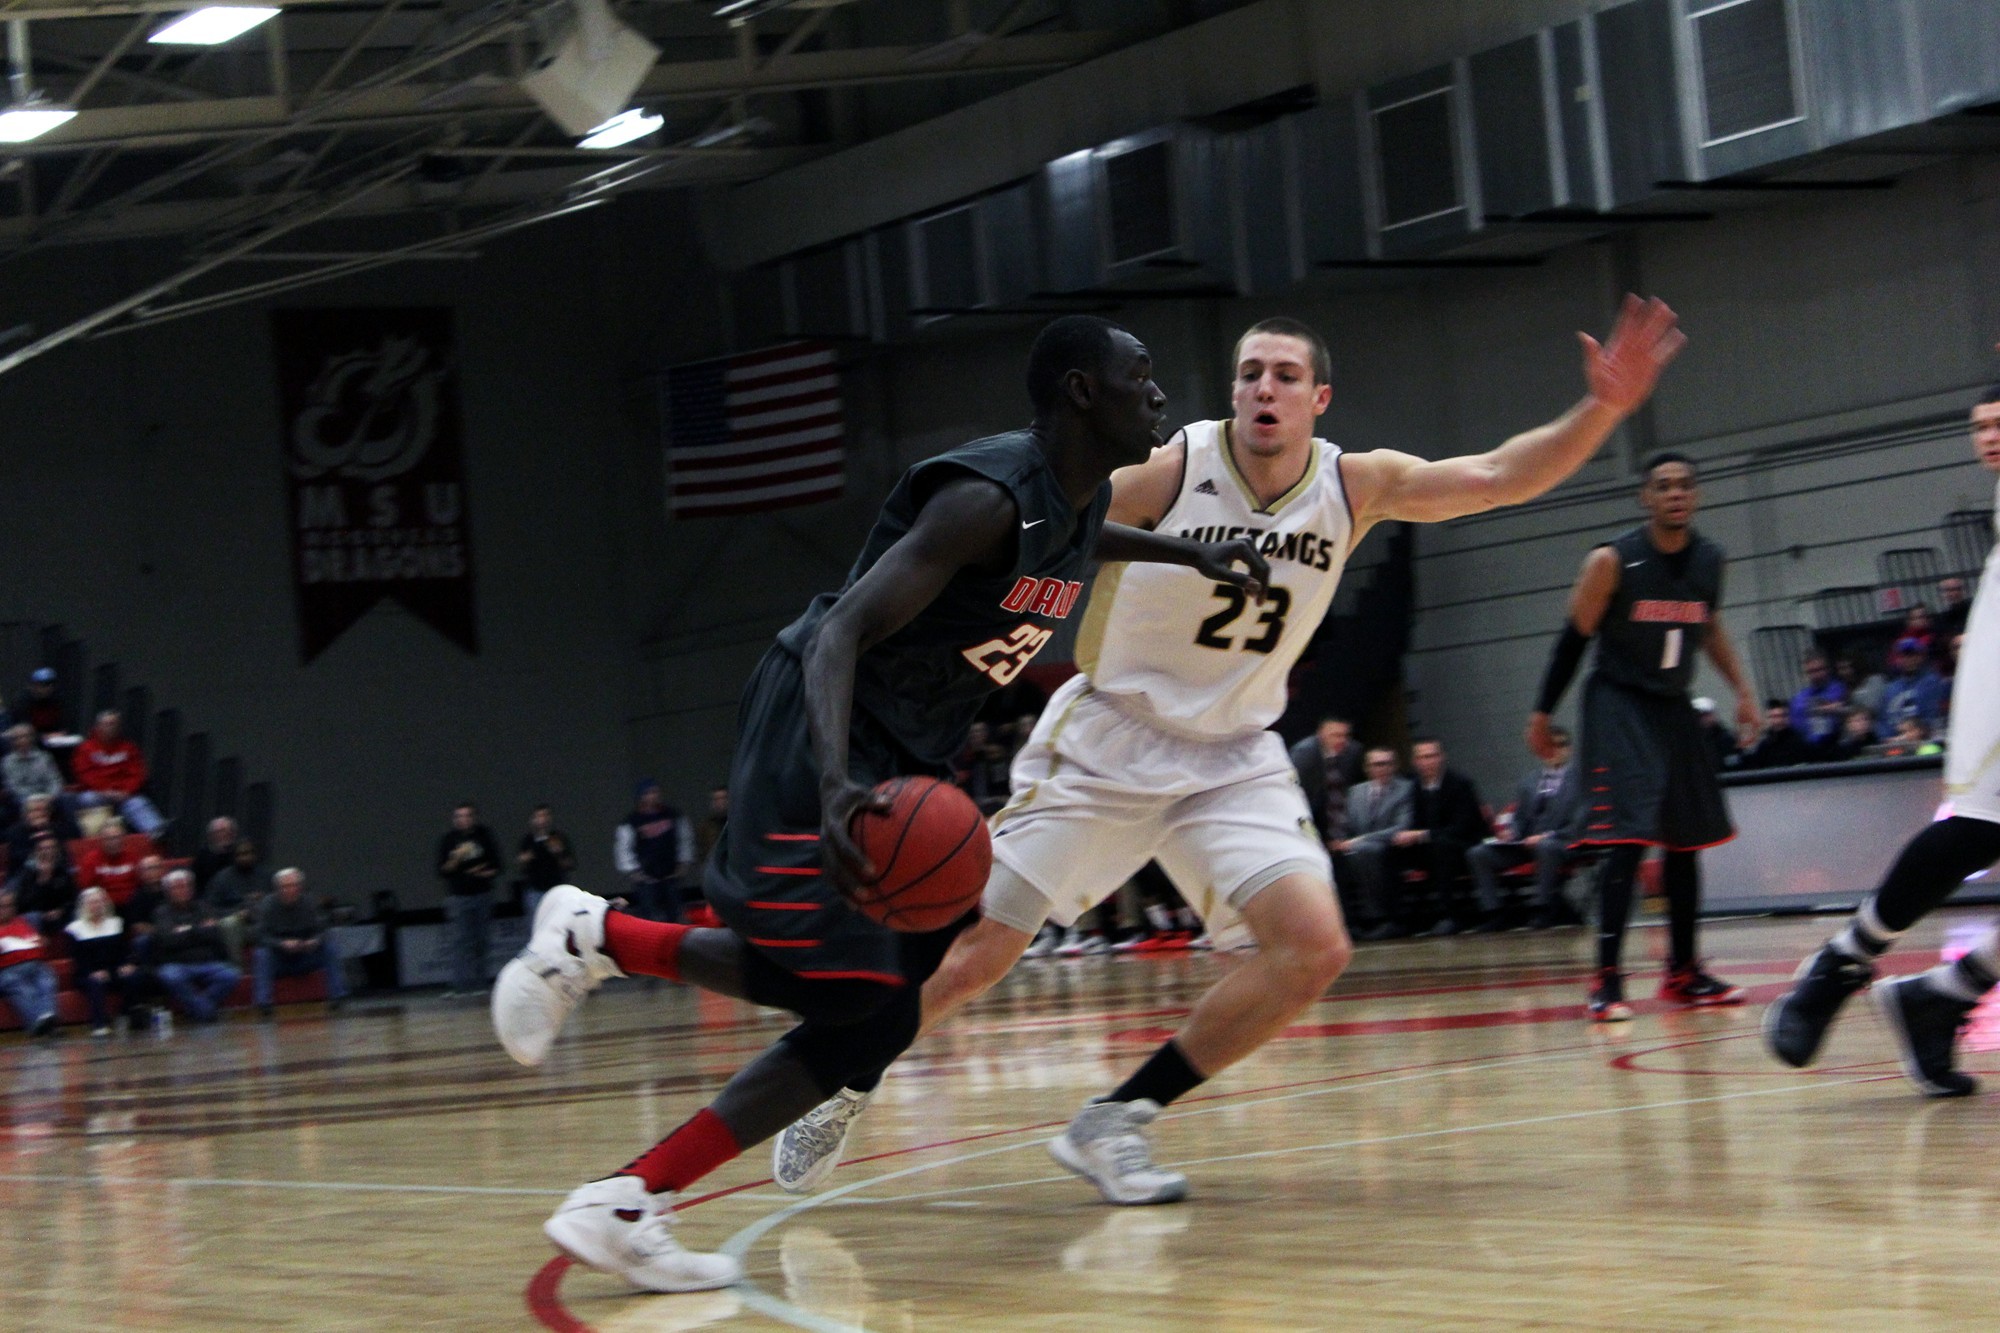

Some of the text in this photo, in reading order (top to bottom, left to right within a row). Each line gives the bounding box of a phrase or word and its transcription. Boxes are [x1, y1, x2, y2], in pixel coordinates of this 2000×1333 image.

[298, 483, 462, 528] MSU
[1194, 583, 1292, 655] 23
[960, 623, 1054, 687] 23
[1660, 627, 1685, 670] 1
